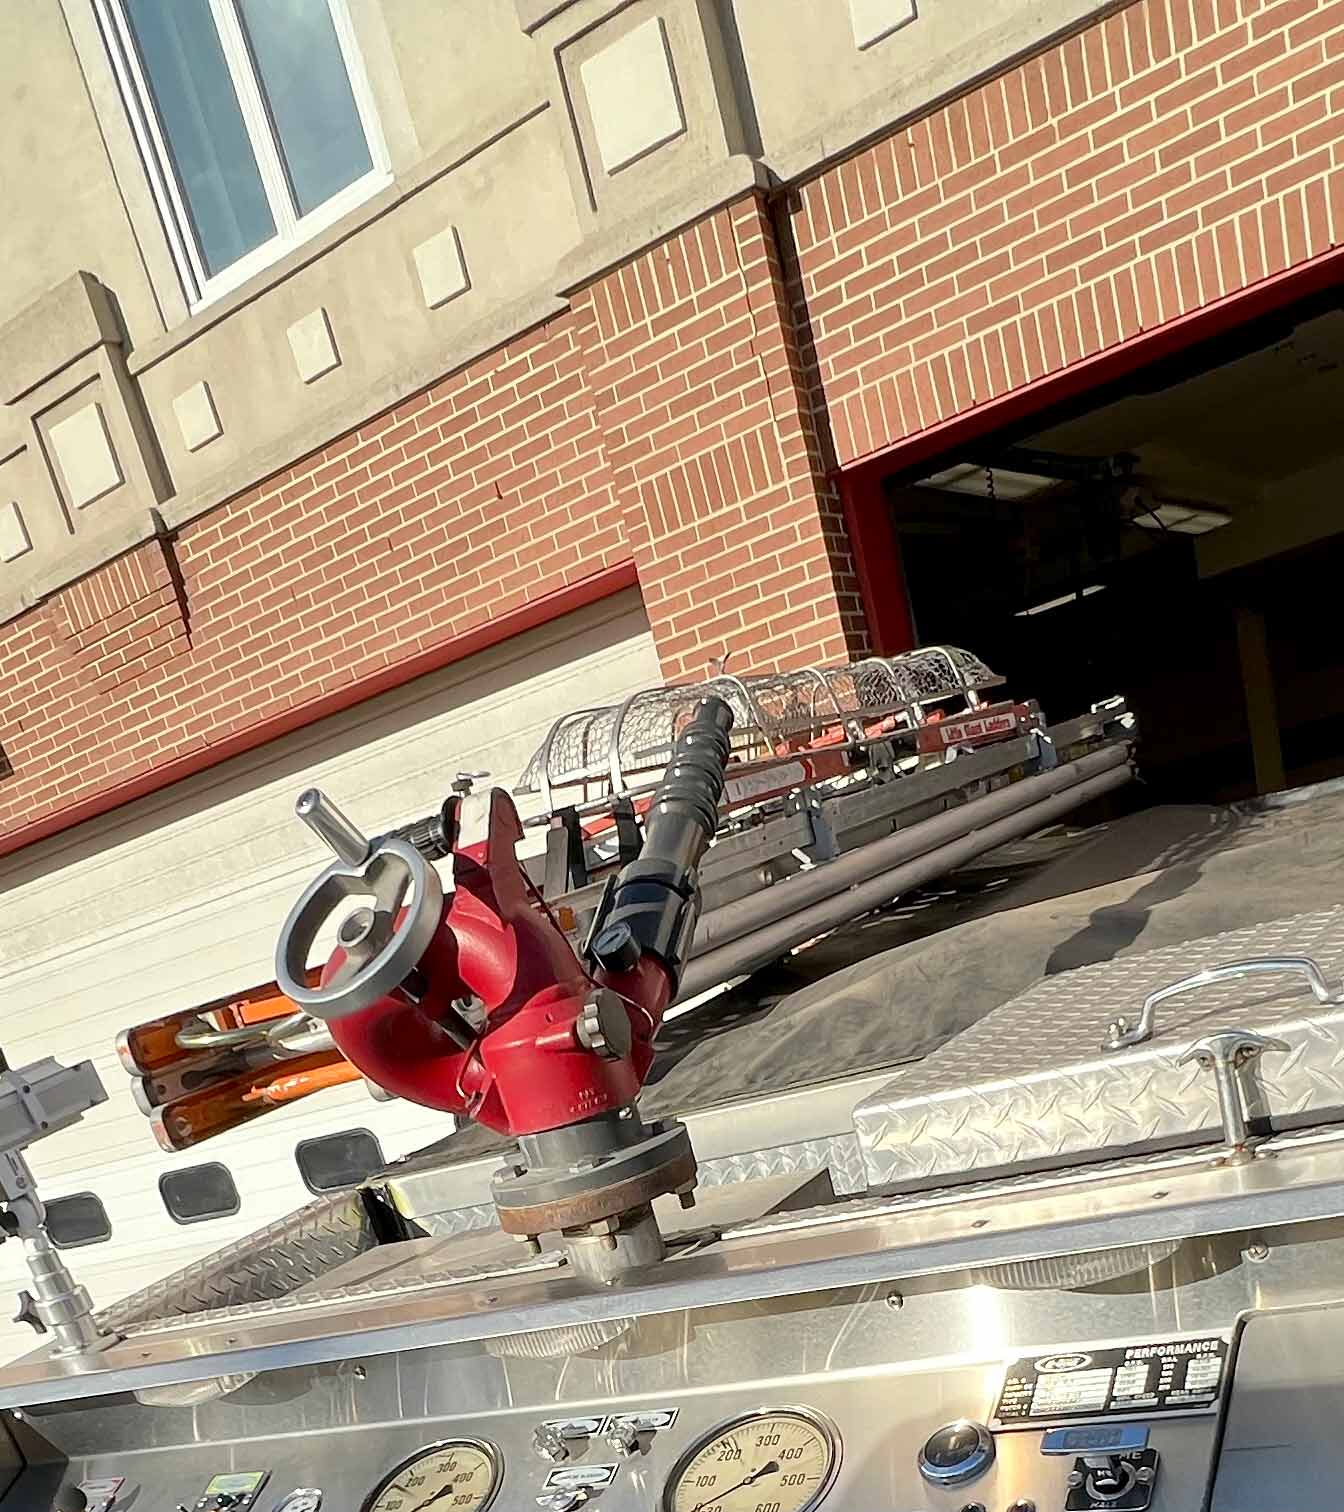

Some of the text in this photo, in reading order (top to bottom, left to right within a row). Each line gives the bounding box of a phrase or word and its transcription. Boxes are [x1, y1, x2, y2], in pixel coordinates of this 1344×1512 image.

[1125, 1340, 1219, 1360] PERFORMANCE
[755, 1434, 781, 1448] 300
[716, 1448, 743, 1462] 200
[777, 1447, 804, 1460] 400
[436, 1461, 458, 1473] 300
[404, 1475, 426, 1488] 200
[453, 1471, 474, 1483] 400
[695, 1475, 717, 1488] 100
[780, 1473, 807, 1487] 500
[384, 1500, 403, 1511] 100
[451, 1494, 473, 1506] 500
